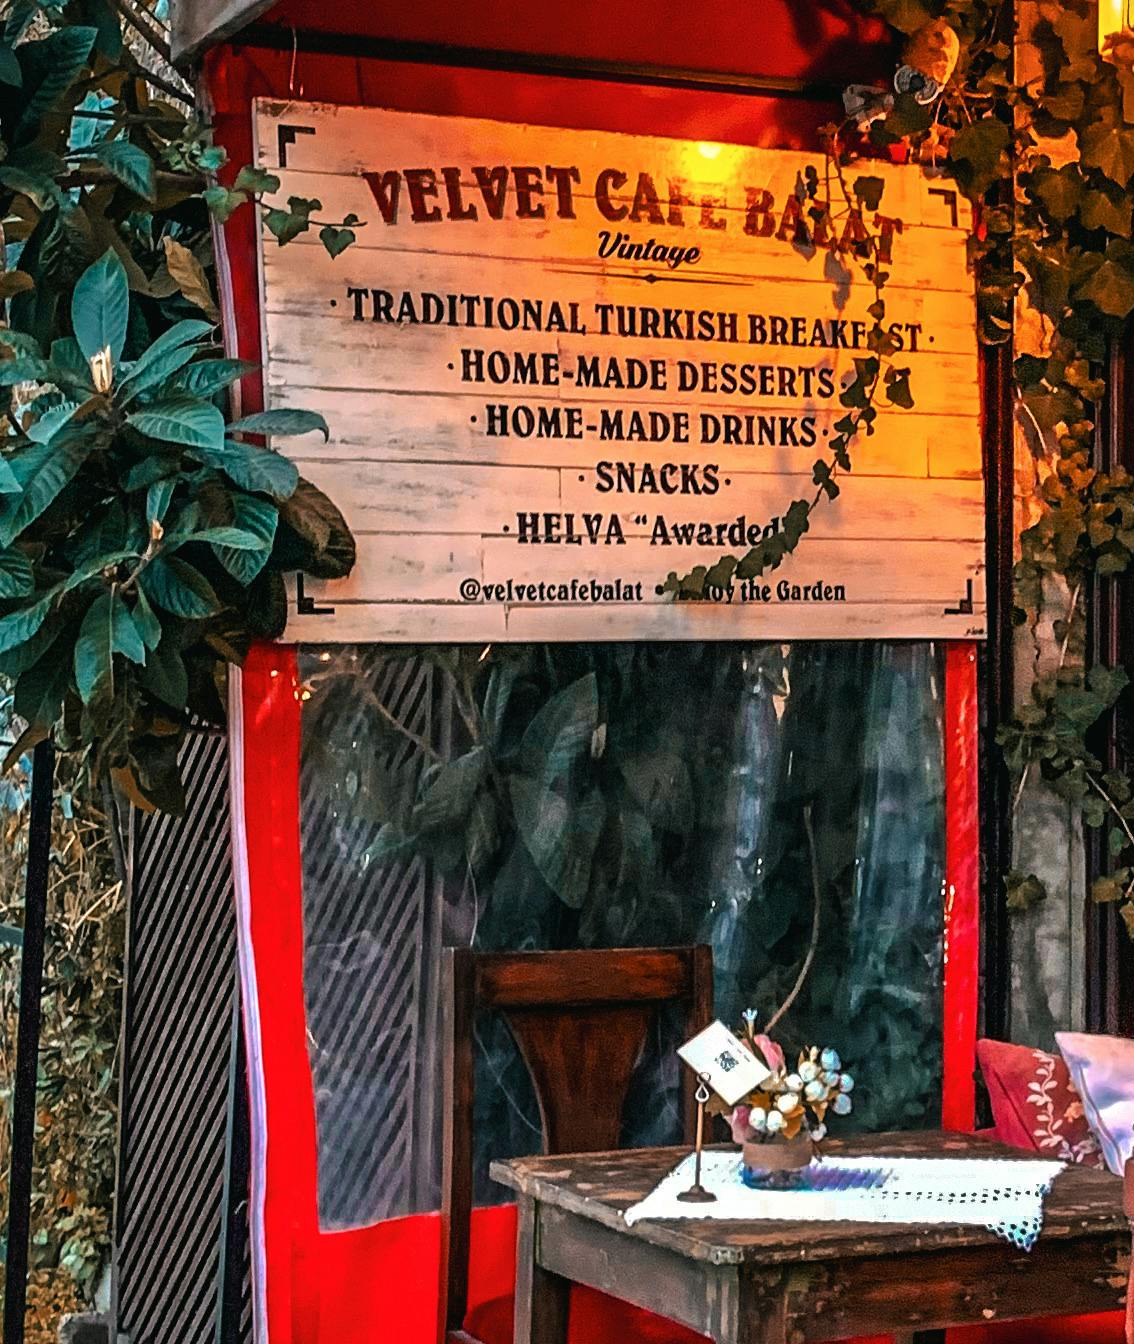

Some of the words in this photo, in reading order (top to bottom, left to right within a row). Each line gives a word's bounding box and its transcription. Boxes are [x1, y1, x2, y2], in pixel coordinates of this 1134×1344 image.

[362, 165, 580, 226] VELVET
[595, 168, 727, 231] CAFE
[598, 231, 701, 269] Vintage
[347, 287, 586, 335] TRADITIONAL
[595, 303, 739, 343] TURKISH
[748, 313, 923, 353] BREAKFST
[460, 349, 666, 390] HOME-MADE
[677, 361, 835, 398] DESSERTS
[486, 404, 690, 444] HOME-MADE
[700, 414, 817, 448] DRINKS
[596, 461, 720, 495] SNACKS
[516, 512, 627, 546] HELVA
[460, 578, 644, 602] @velvetcafebalat
[741, 579, 771, 602] the
[776, 579, 847, 602] Garden
